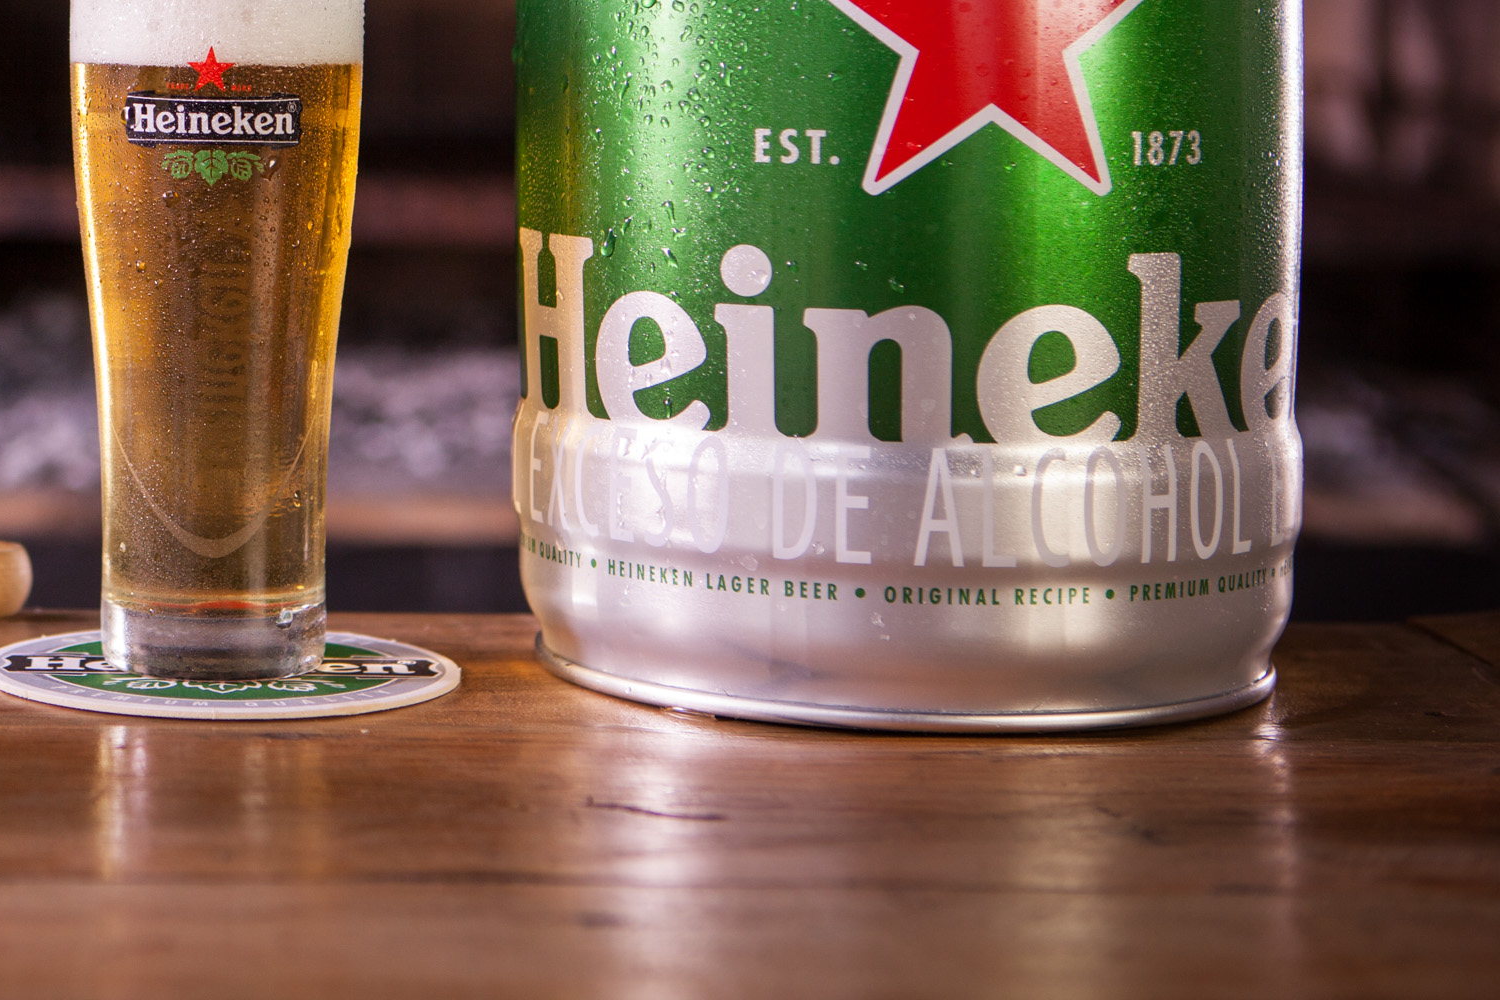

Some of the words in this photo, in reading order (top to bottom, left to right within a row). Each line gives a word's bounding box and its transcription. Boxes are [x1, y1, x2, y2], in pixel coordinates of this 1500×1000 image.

[754, 128, 840, 165] EST.
[1131, 129, 1202, 166] 1873
[529, 410, 731, 555] EXCESO
[771, 444, 873, 566] DE
[913, 437, 1253, 569] ALCOHOL
[540, 542, 582, 568] QUALITY
[607, 558, 693, 588] HEINEKEN
[706, 573, 770, 596] LAGER
[784, 581, 838, 601] BEER
[884, 585, 1000, 606] ORIGINAL
[1015, 586, 1090, 605] RECIPE
[1129, 577, 1210, 602] PREMIUM
[1218, 566, 1267, 594] QUALITY
[51, 685, 209, 706] PREMIUM
[244, 689, 391, 707] QUALITY
